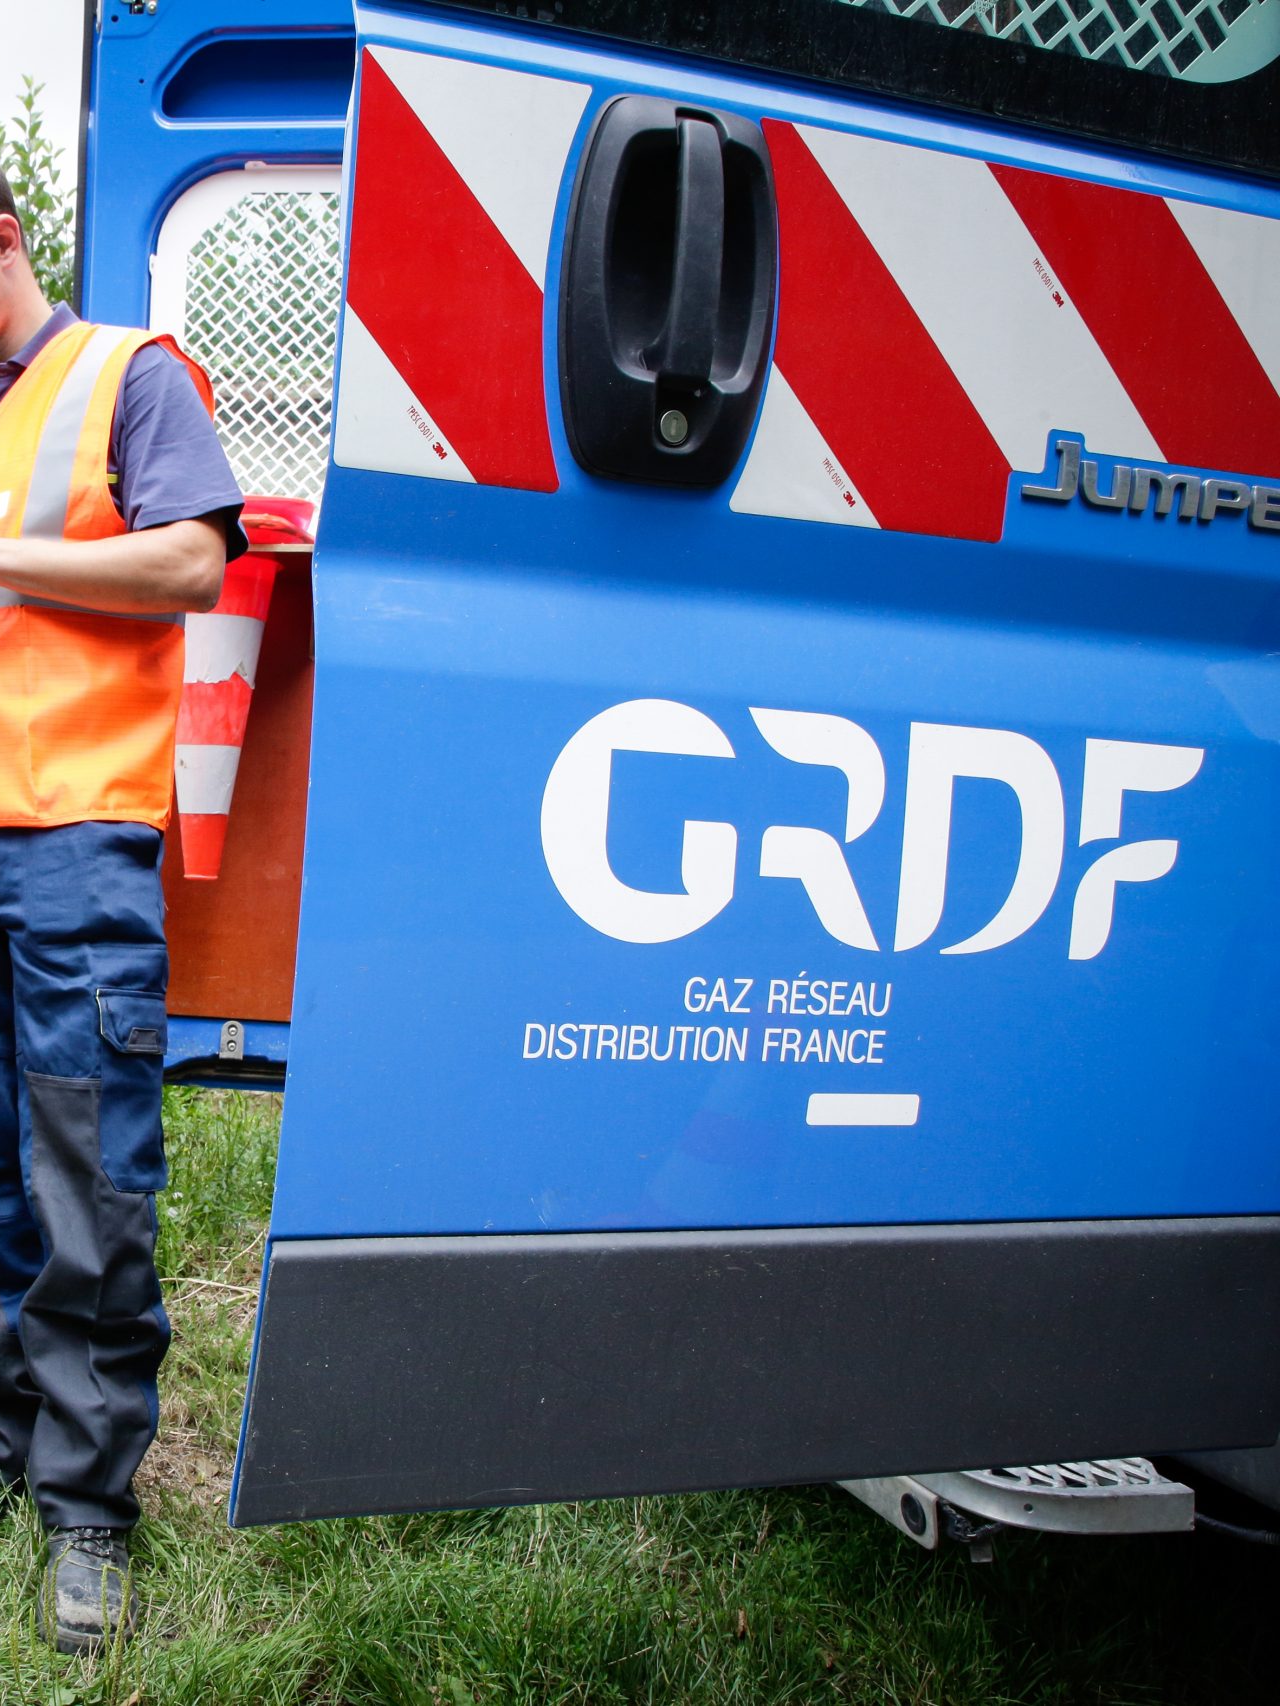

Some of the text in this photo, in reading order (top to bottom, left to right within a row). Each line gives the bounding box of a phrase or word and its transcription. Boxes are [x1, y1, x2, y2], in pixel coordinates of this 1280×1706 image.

[1052, 290, 1065, 308] 3M
[406, 405, 423, 425] TPESC
[432, 441, 448, 460] 3M
[843, 490, 856, 508] 3M
[540, 698, 1205, 961] GRDF
[683, 971, 893, 1017] GAZ RÉSEAU
[522, 1022, 887, 1064] DISTRIBUTION FRANCE
